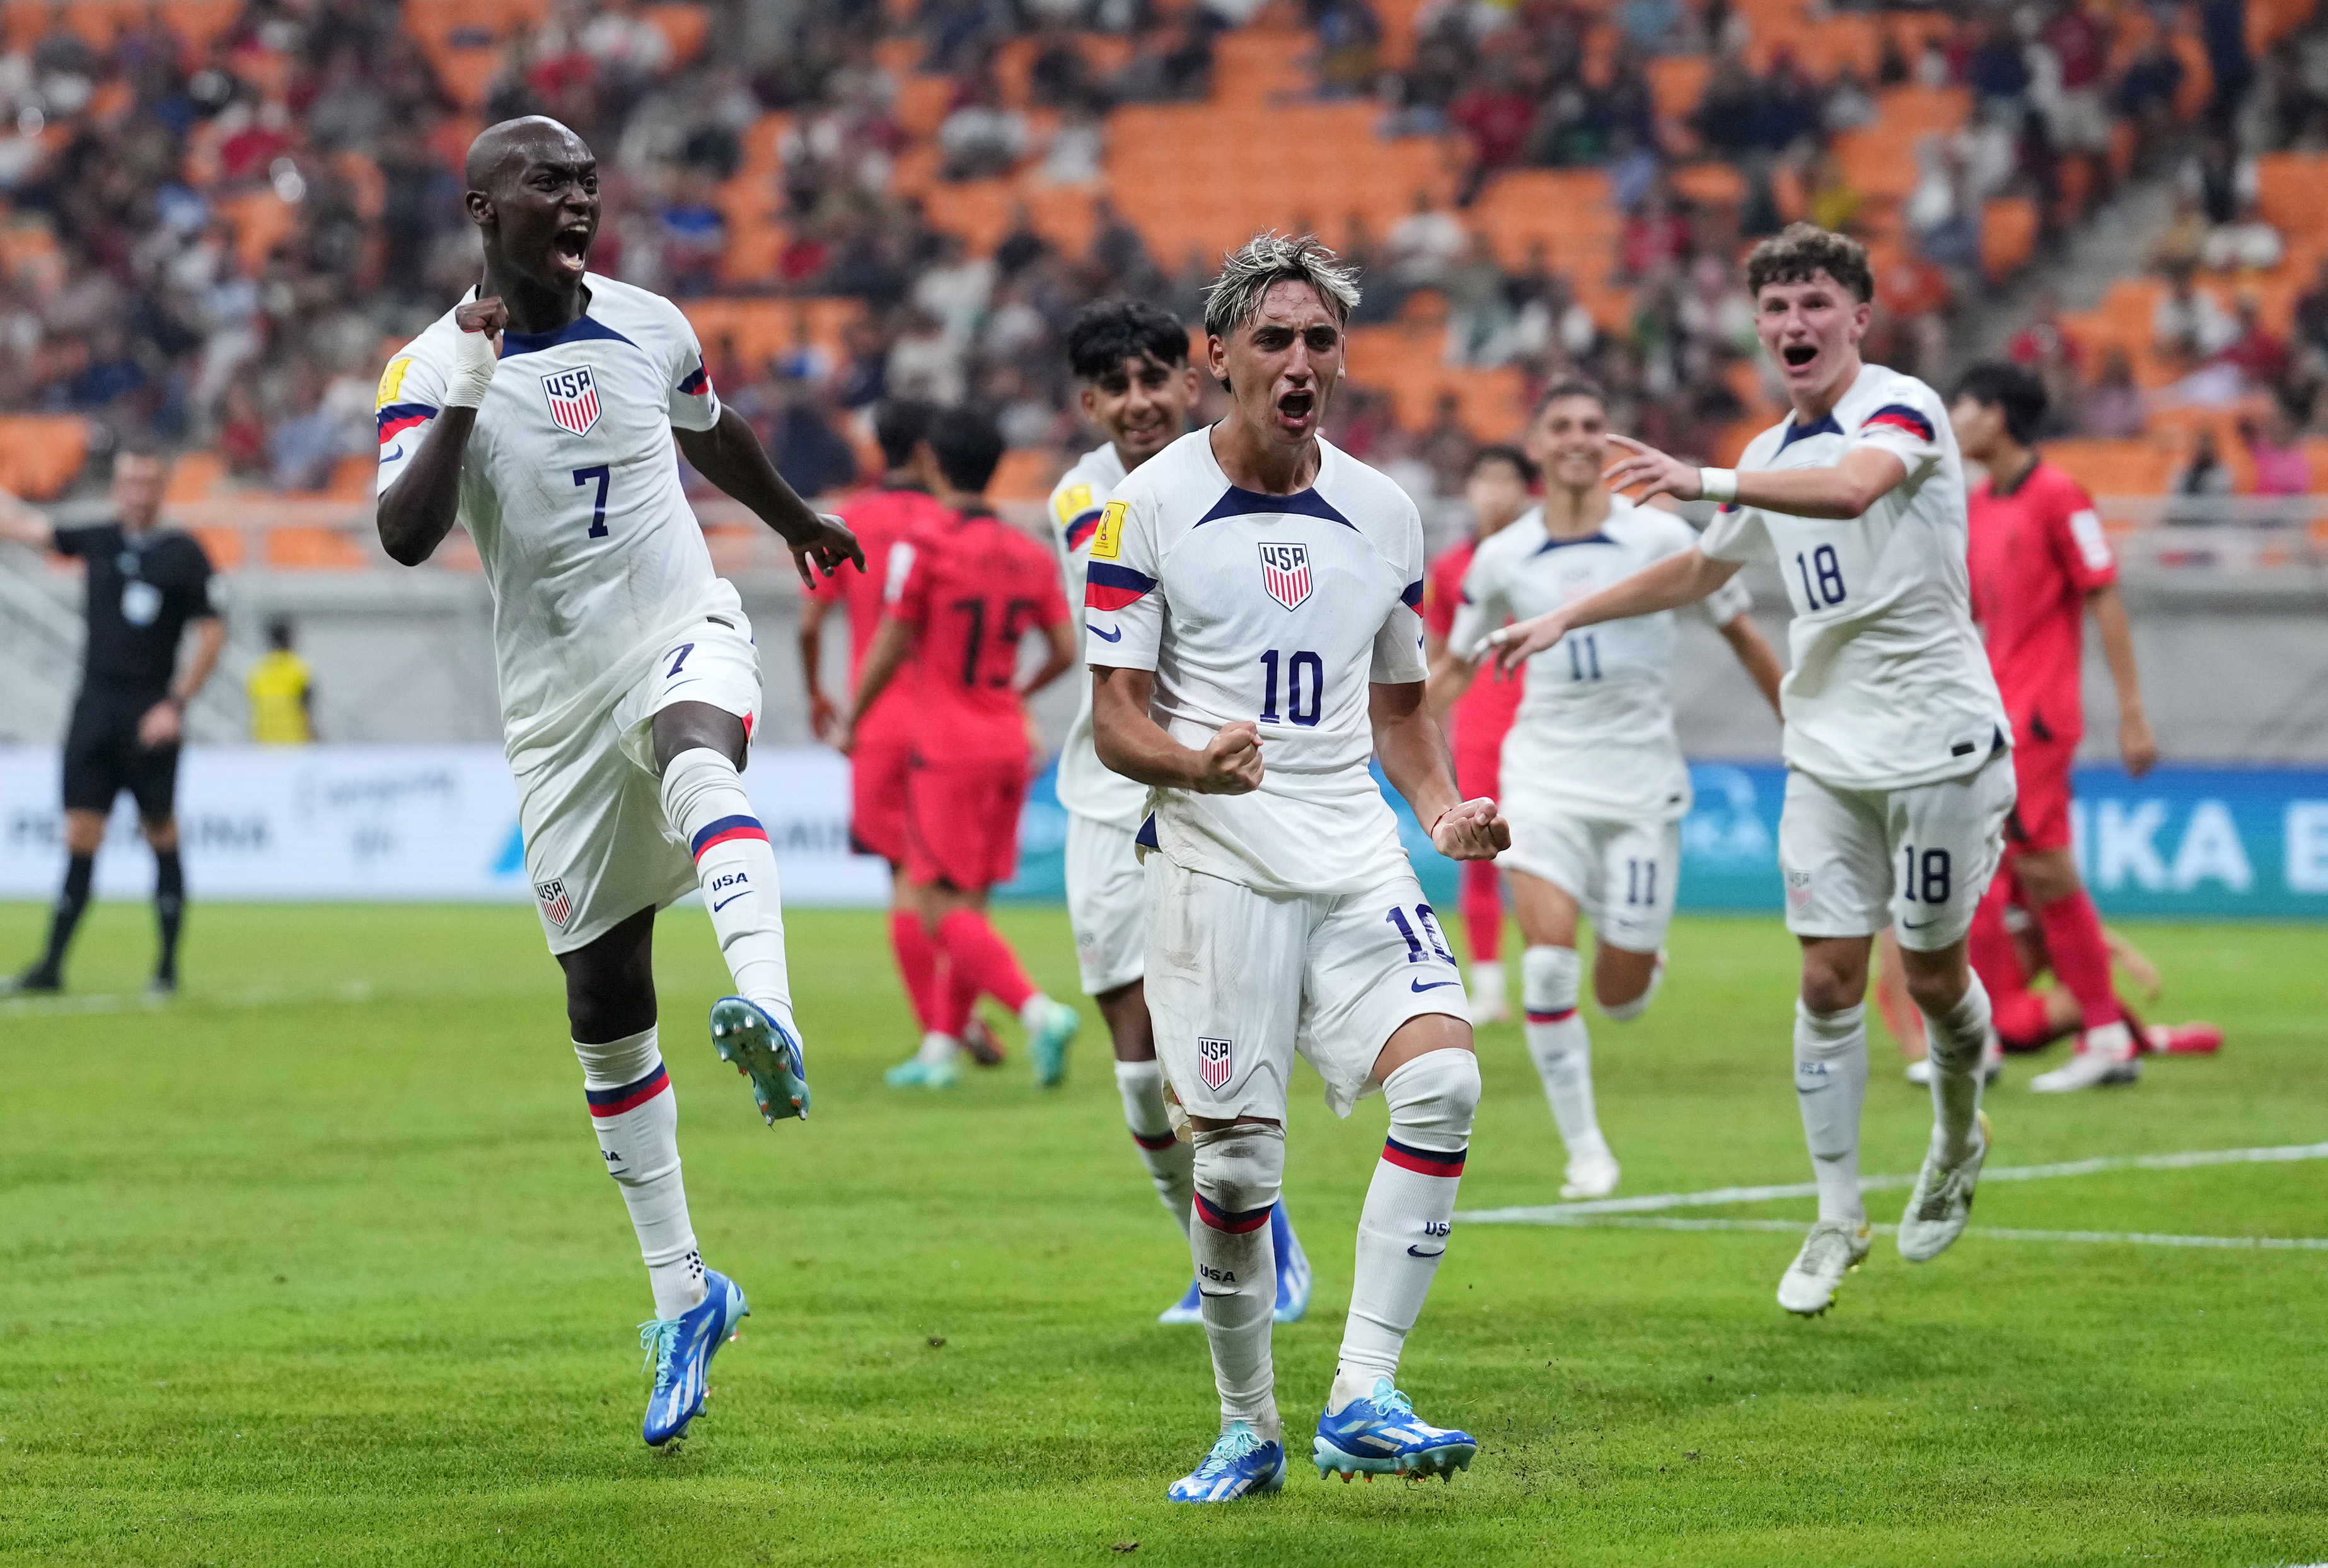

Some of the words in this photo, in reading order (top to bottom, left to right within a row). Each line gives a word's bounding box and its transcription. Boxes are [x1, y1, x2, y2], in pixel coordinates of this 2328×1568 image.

[546, 370, 591, 398] USA
[572, 463, 610, 539] 7
[1263, 546, 1305, 571] USA
[1795, 544, 1847, 611] 18
[662, 643, 695, 679] 7
[1568, 633, 1602, 682] 11
[1260, 649, 1323, 727] 10
[712, 873, 748, 891] USA
[1626, 858, 1657, 908] 11
[1904, 845, 1951, 904] 18
[537, 881, 562, 901] USA
[1201, 1041, 1229, 1061] USA
[601, 1150, 622, 1161] SA
[1200, 1263, 1236, 1282] USA
